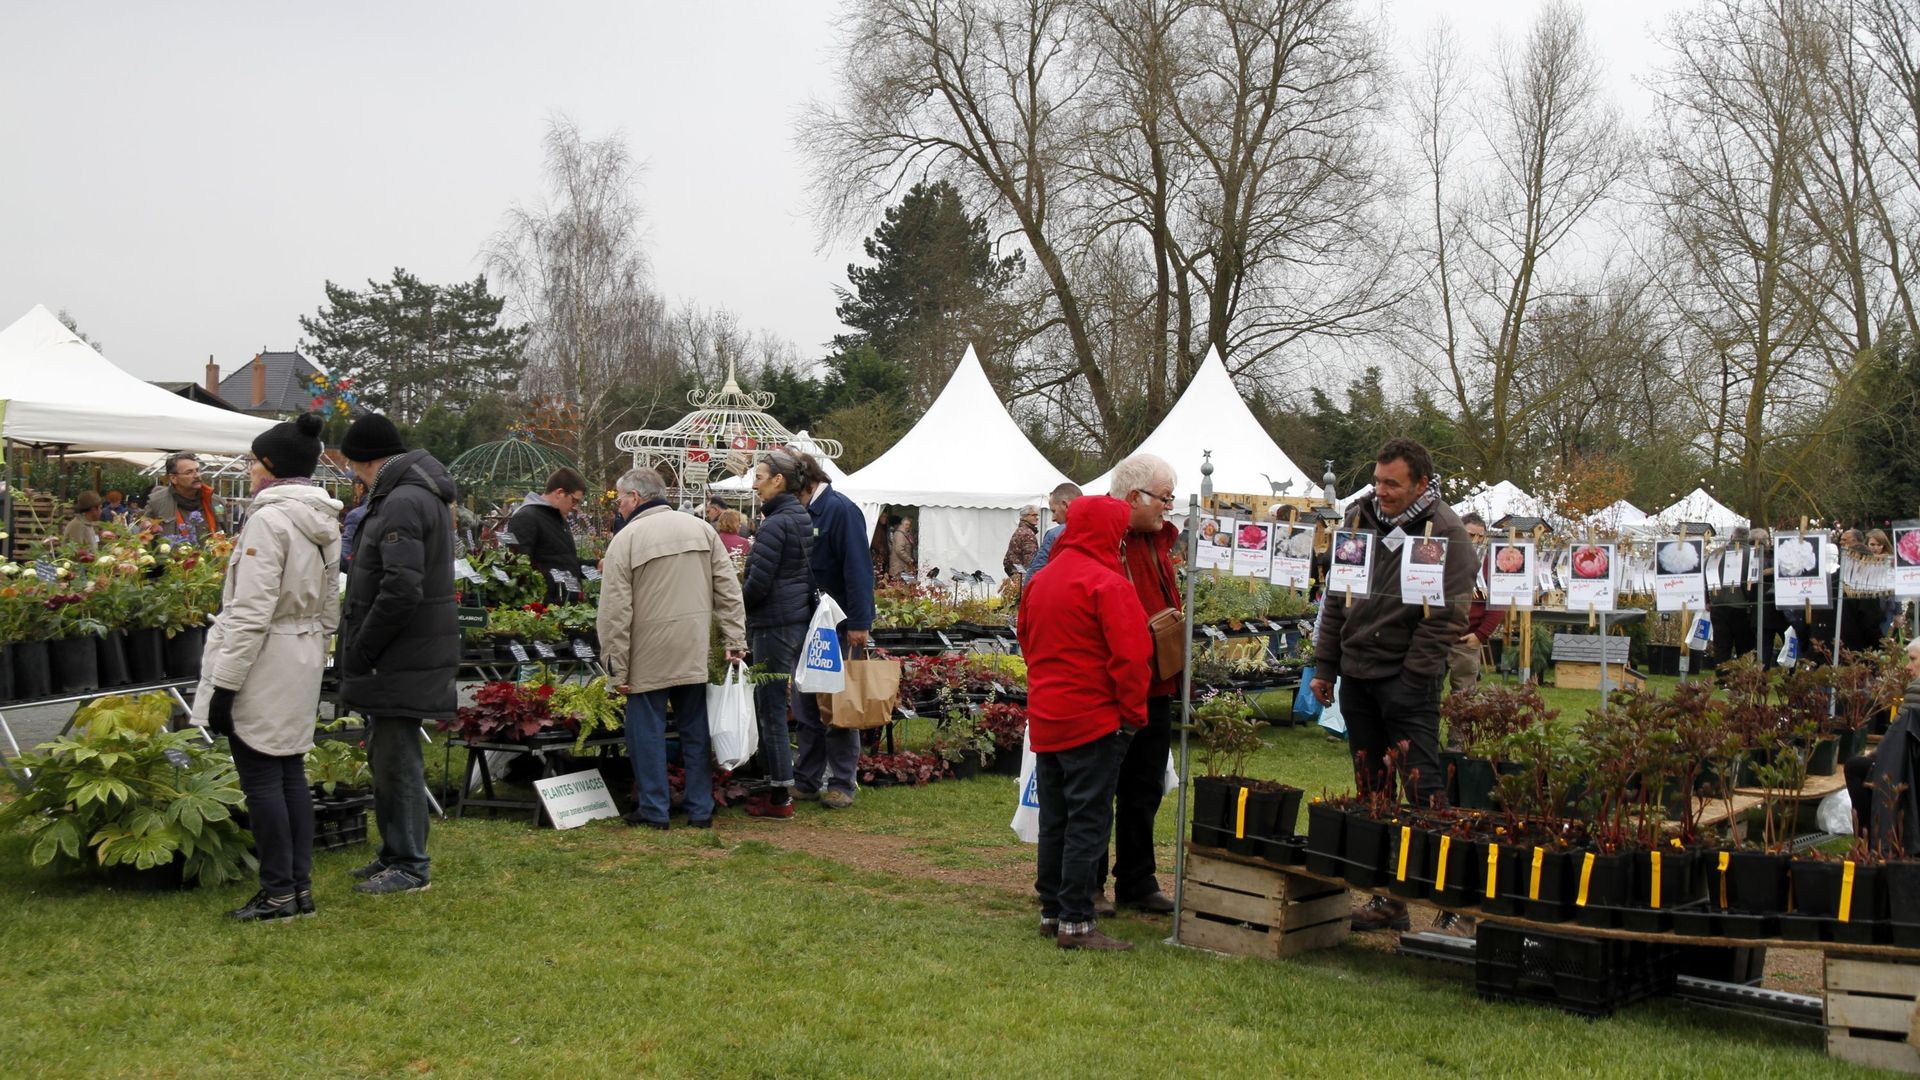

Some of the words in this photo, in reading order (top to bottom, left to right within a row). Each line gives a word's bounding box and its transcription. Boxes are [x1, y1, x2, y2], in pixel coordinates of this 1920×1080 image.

[811, 640, 831, 651] VOIX
[810, 648, 823, 658] DU
[808, 656, 834, 669] NORD
[542, 783, 574, 800] PLANTES
[572, 777, 605, 793] VIVACES
